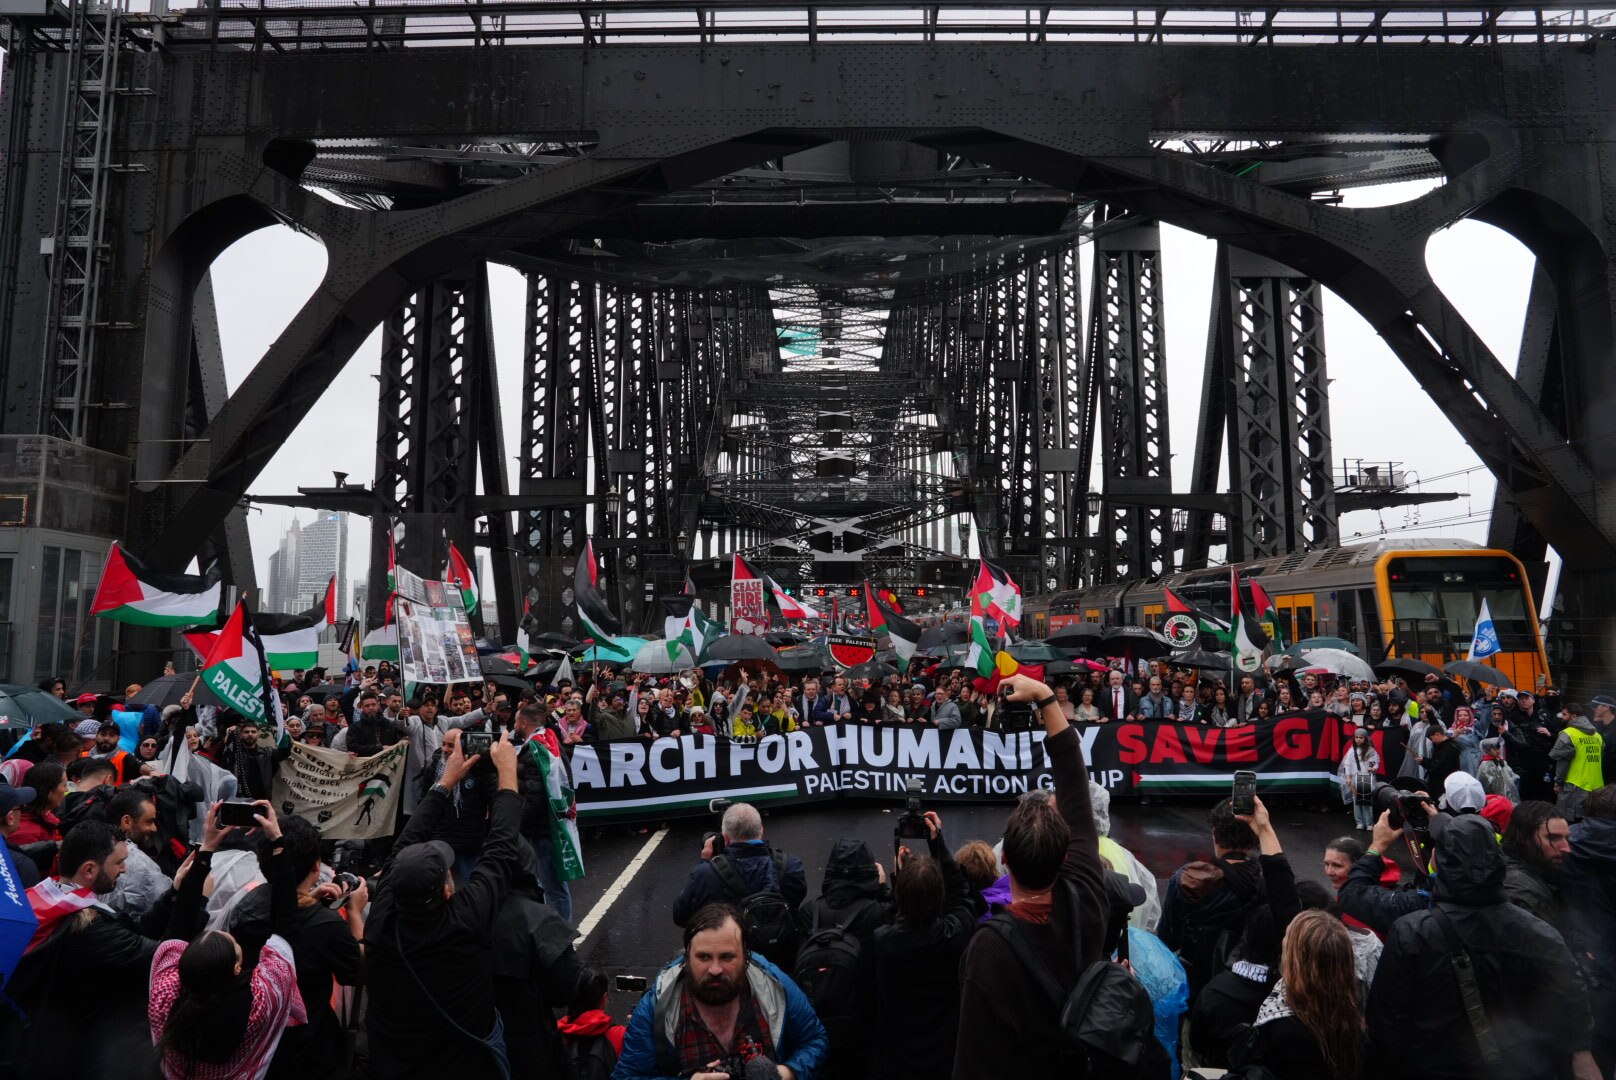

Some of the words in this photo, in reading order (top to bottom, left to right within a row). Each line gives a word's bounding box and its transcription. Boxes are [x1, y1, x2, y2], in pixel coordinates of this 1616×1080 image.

[733, 581, 762, 592] CEASE
[733, 591, 763, 608] FIRE
[845, 639, 877, 647] PALESTINE
[211, 669, 265, 719] PALEST
[570, 733, 717, 790] ARCH
[729, 730, 819, 777] FOR
[1115, 723, 1259, 765] SAVE
[281, 777, 307, 791] Right
[933, 773, 1028, 794] ACTION
[1036, 769, 1124, 793] GUP
